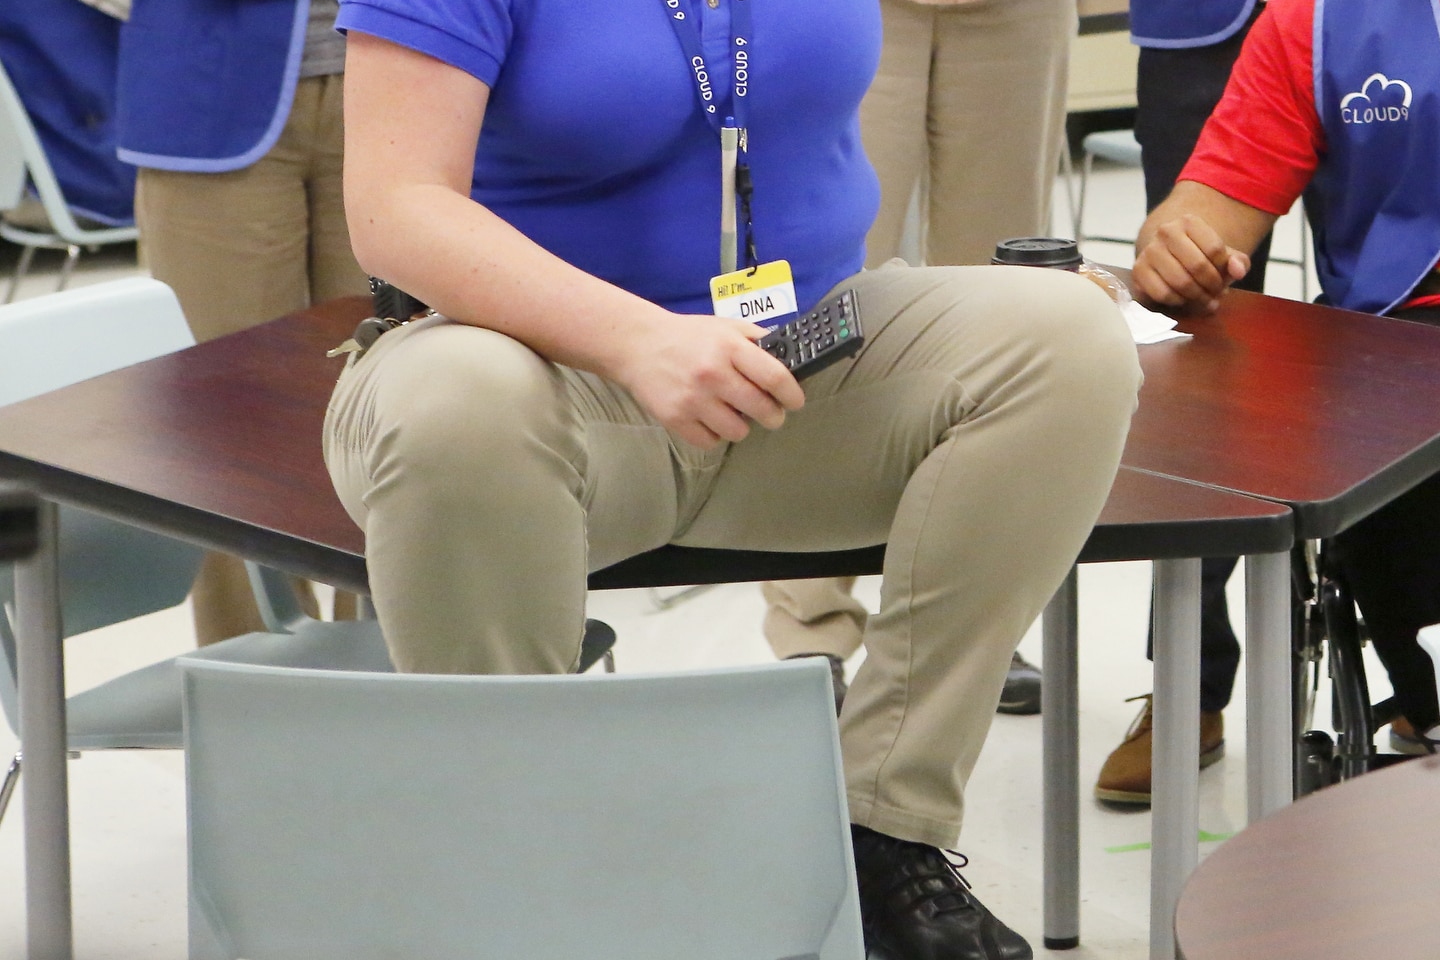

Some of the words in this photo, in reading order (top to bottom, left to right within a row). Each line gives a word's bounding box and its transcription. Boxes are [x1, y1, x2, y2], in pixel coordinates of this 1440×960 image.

[674, 11, 685, 20] 9
[736, 37, 748, 46] 9
[736, 50, 748, 97] CLOUD
[692, 56, 713, 101] CLOUD
[707, 104, 716, 114] 9
[1341, 106, 1409, 124] CLOUD9
[740, 296, 775, 318] DINA
